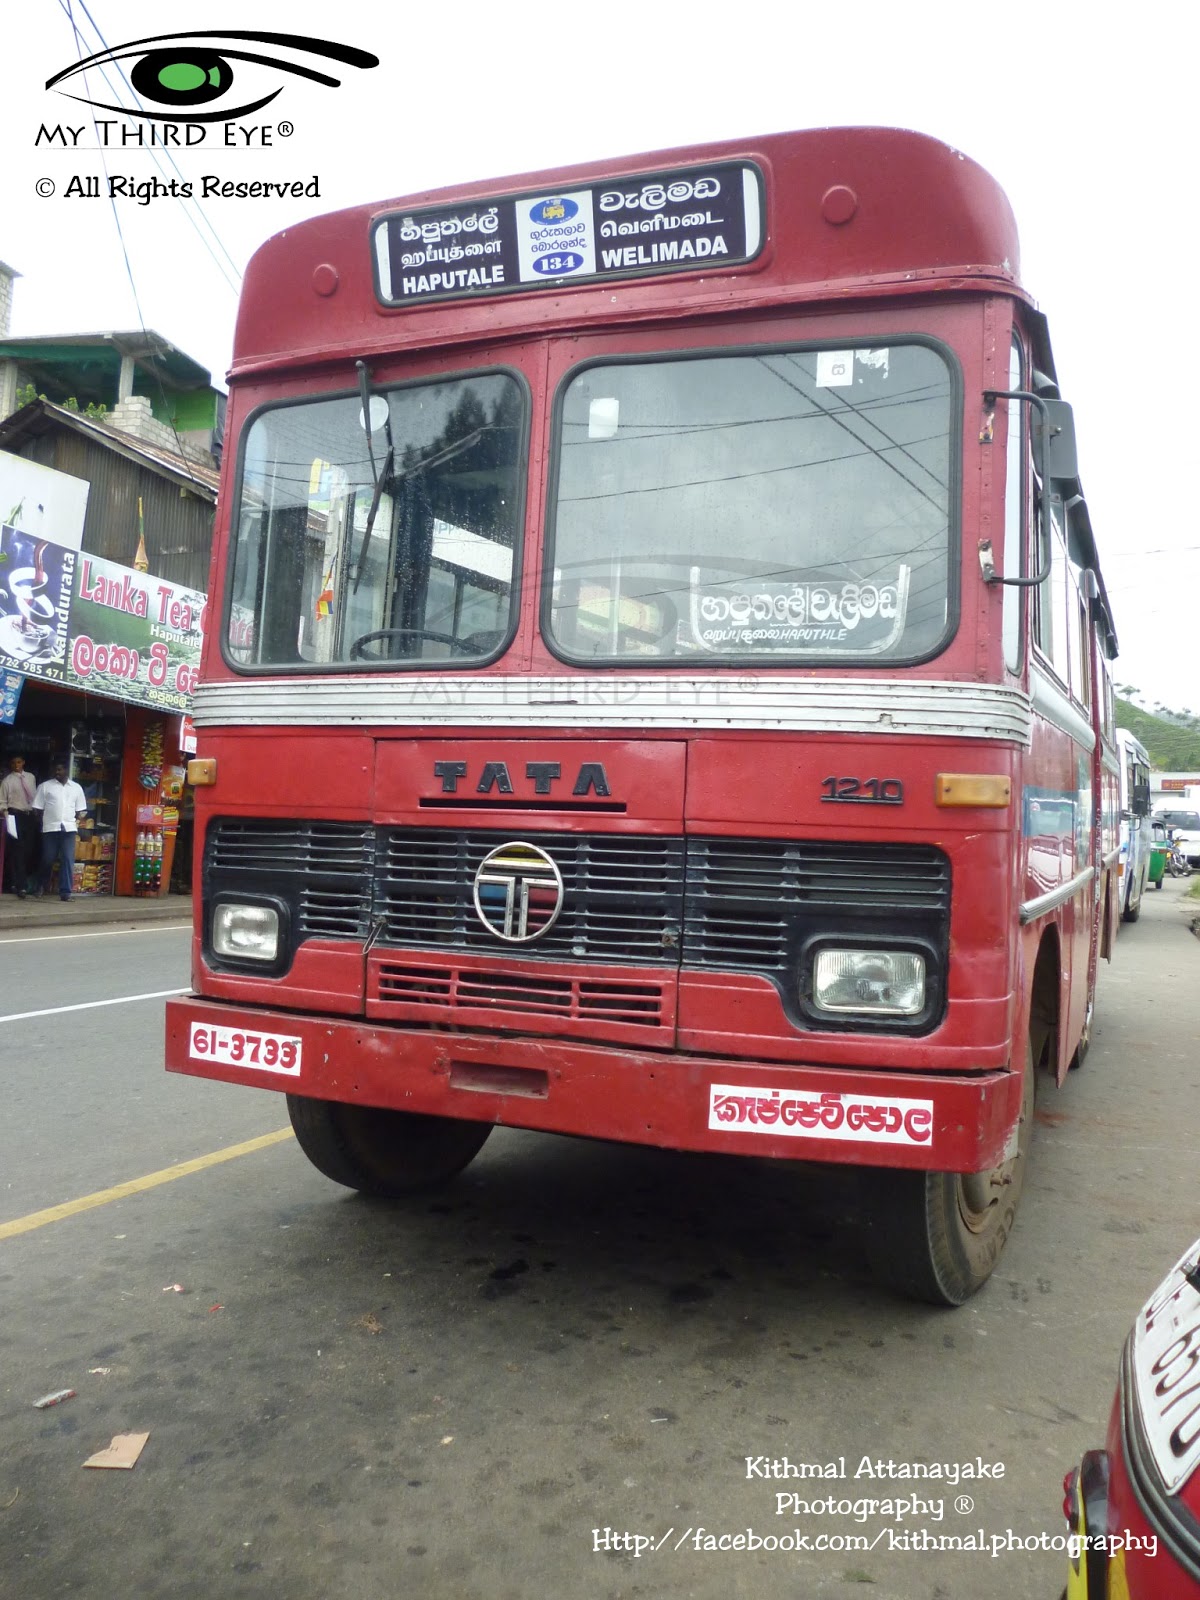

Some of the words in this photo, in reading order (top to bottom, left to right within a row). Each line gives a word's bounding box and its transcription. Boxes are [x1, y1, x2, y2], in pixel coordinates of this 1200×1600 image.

[599, 178, 721, 212] වැලිමඩ
[540, 255, 576, 271] 134
[602, 235, 729, 268] WELIMADA
[403, 265, 505, 294] HAPUTALE
[50, 551, 75, 664] Kandurata
[79, 560, 149, 619] Lanka
[156, 585, 193, 632] Tea
[149, 623, 201, 649] Haputale
[23, 662, 42, 674] 985
[46, 668, 64, 680] 471
[434, 761, 611, 796] TATA
[821, 775, 904, 801] 1210
[193, 1028, 298, 1069] 61-3733
